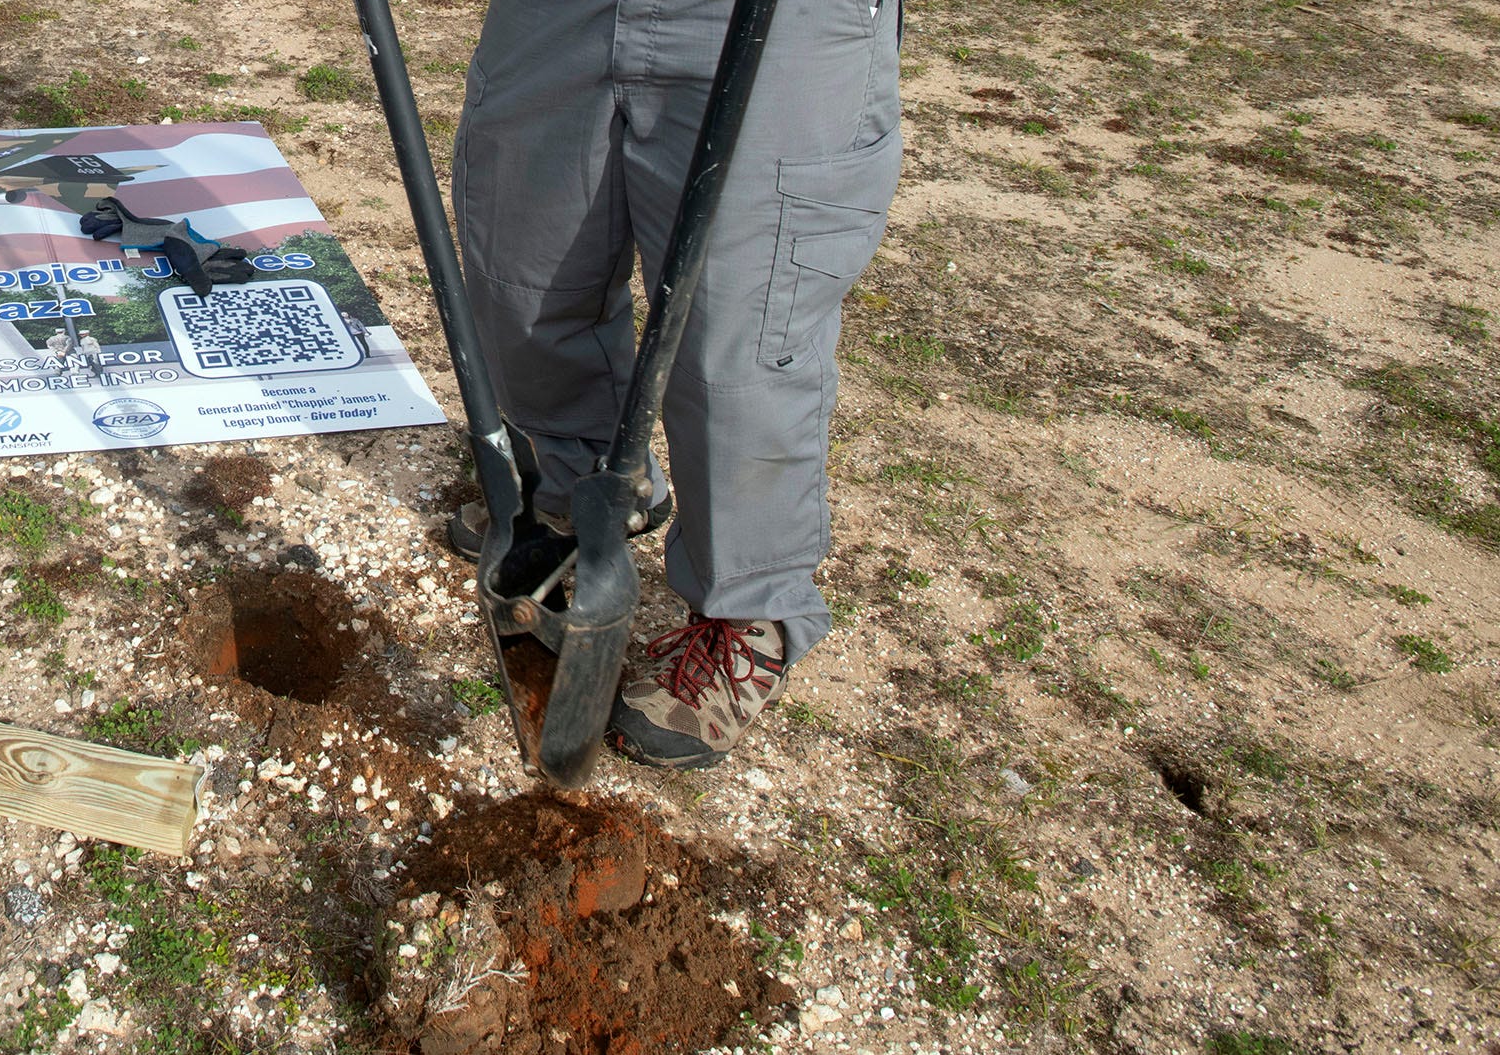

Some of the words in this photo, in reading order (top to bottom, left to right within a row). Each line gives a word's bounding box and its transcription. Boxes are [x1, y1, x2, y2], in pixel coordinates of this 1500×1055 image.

[141, 252, 317, 280] Jes
[97, 349, 164, 366] FOR
[100, 368, 180, 387] INFO
[261, 386, 307, 398] Become
[308, 386, 317, 394] a
[198, 403, 244, 416] General
[245, 400, 281, 412] Daniel
[282, 395, 338, 410] "Chappie"
[340, 394, 377, 405] James
[377, 393, 391, 402] Jr.
[111, 414, 154, 425] RBA
[223, 416, 266, 430] Legacy
[266, 414, 301, 425] Donor
[310, 409, 337, 421] Give
[337, 406, 378, 420] Today!
